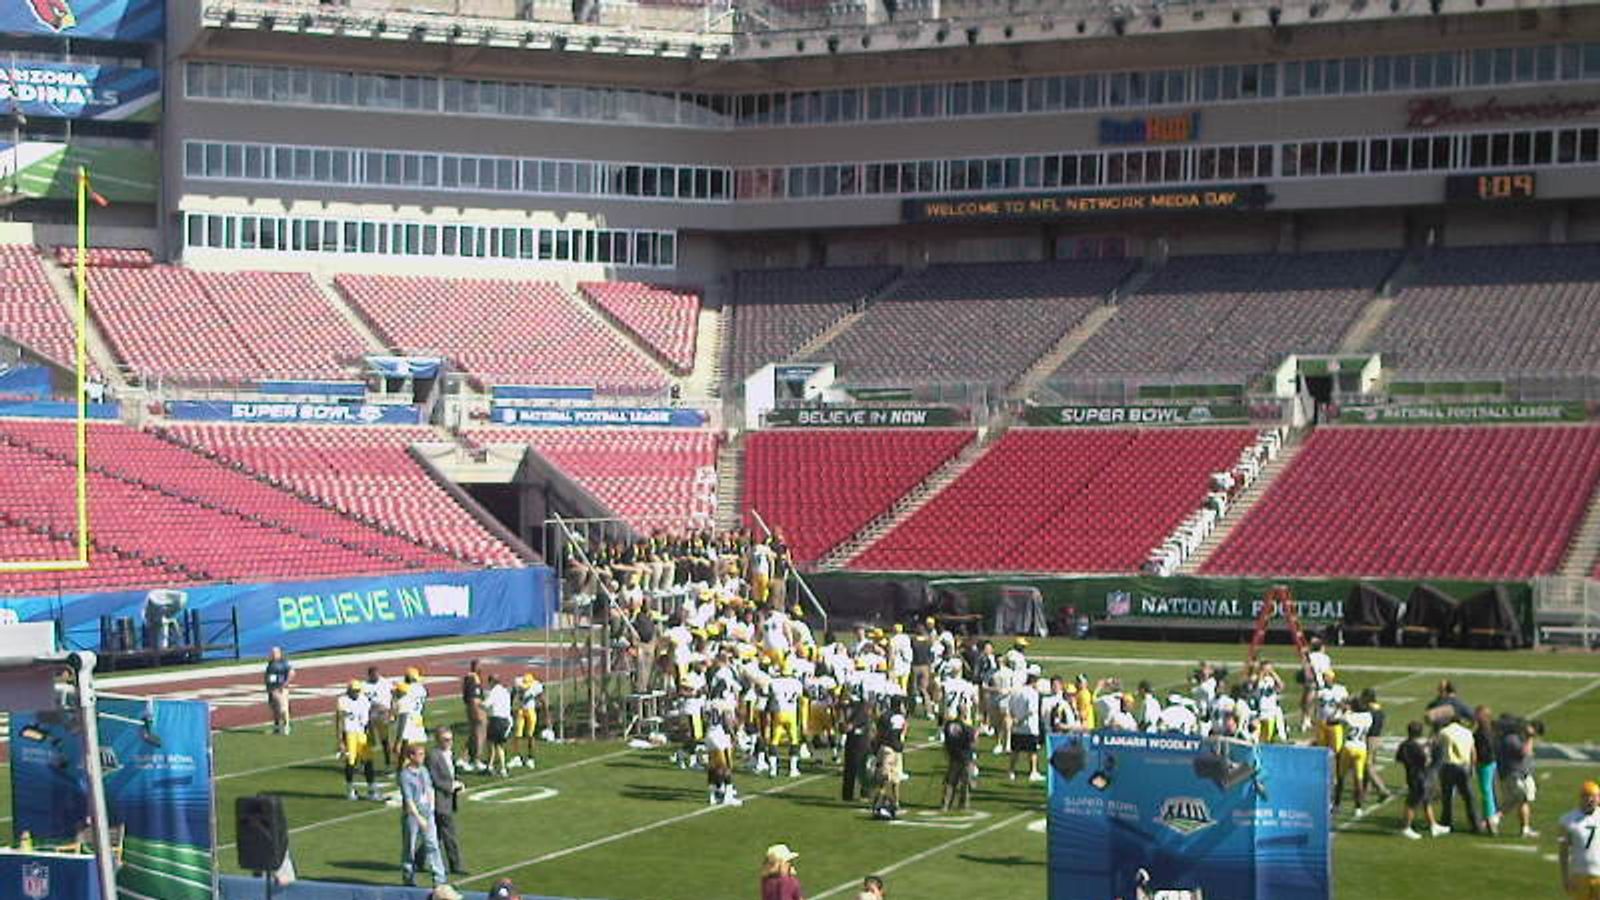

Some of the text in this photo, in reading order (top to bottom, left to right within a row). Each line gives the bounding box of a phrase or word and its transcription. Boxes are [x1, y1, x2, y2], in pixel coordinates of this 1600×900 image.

[927, 192, 1237, 216] WELCOME TO NFL NETWORK MEDIA DAY
[231, 403, 297, 418] SUPER
[299, 404, 355, 419] BOWL
[798, 410, 927, 425] BELIEVE IN NOW
[1060, 408, 1125, 423] SUPER
[1128, 408, 1184, 422] BOWL
[278, 589, 396, 631] BELIEVE
[396, 586, 424, 618] IN
[1141, 597, 1243, 616] NATIONAL
[1148, 738, 1201, 750] WOODLEY
